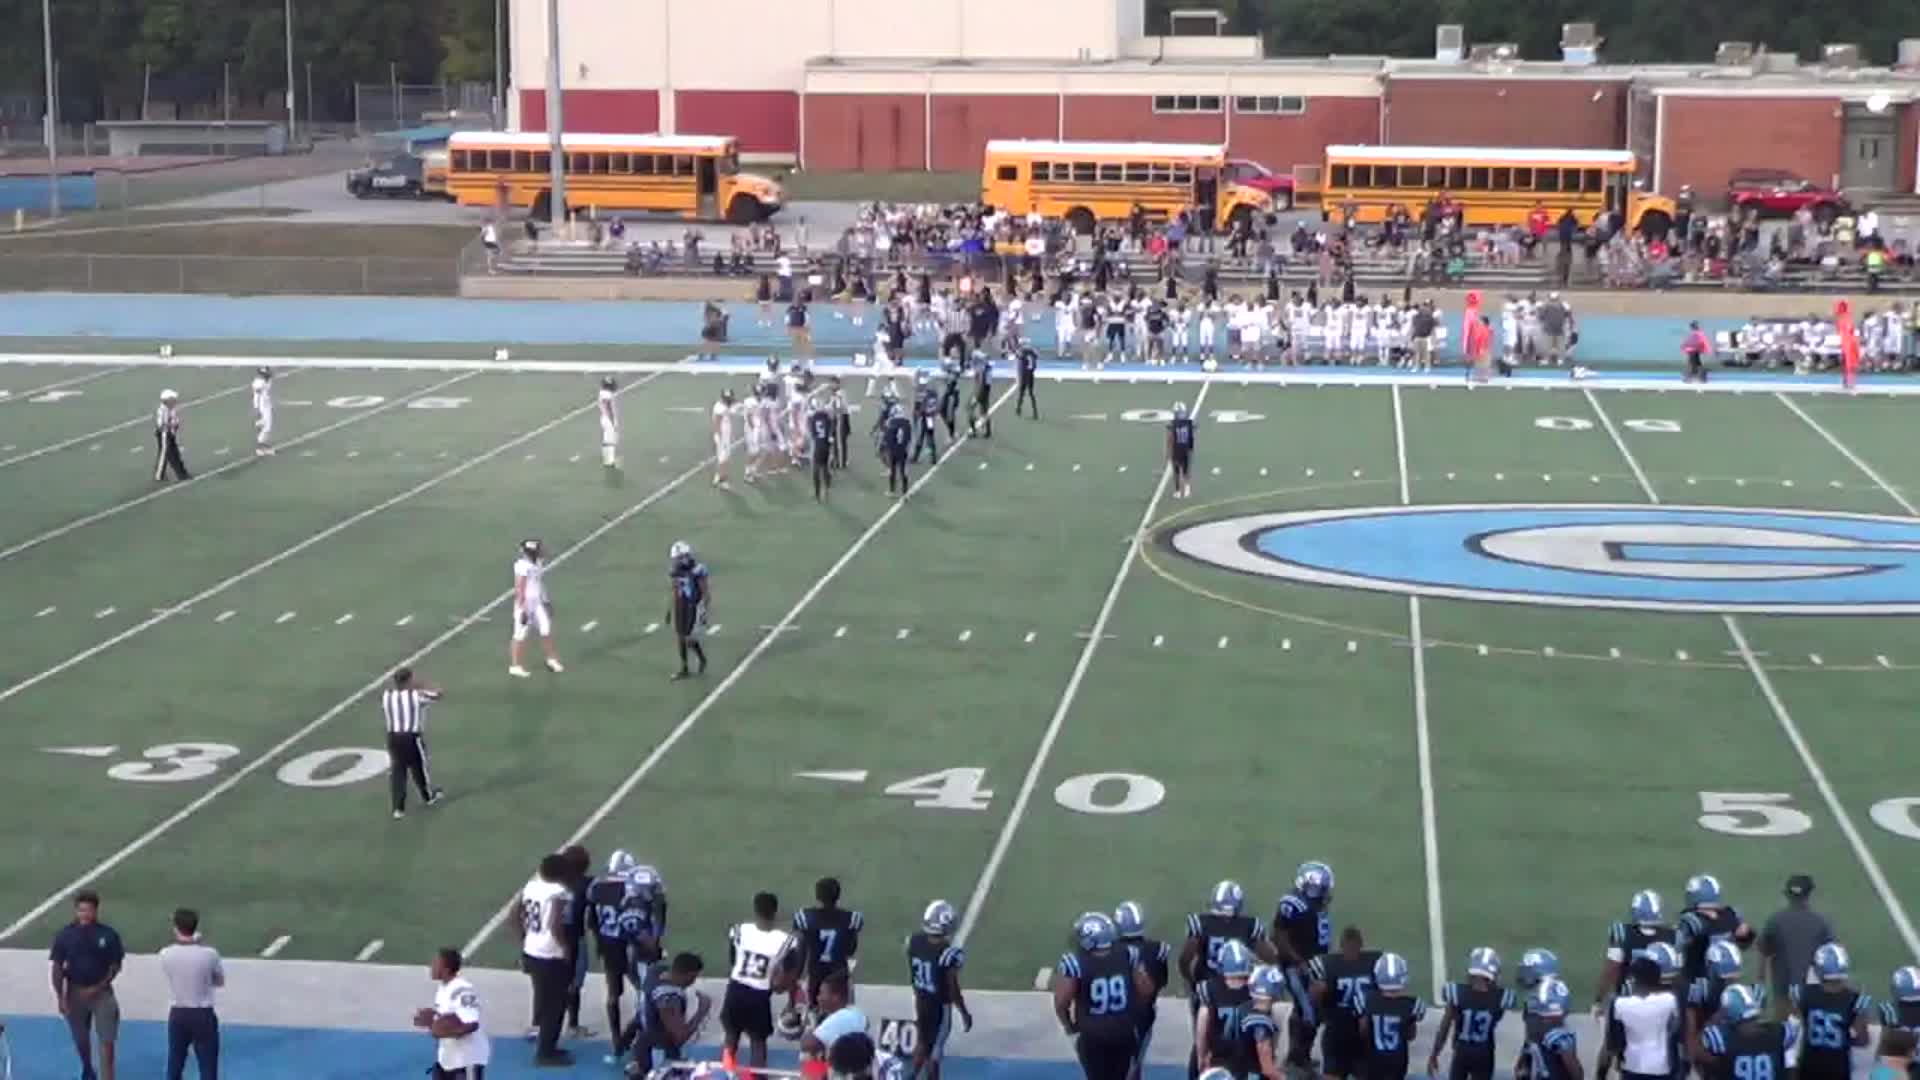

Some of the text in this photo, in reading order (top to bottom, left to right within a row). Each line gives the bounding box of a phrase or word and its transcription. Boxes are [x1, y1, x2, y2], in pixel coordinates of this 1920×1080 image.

[884, 767, 1165, 813] 40
[818, 928, 838, 962] 7
[1089, 975, 1128, 1014] 99
[881, 1022, 918, 1055] 40
[1372, 1015, 1400, 1051] 15
[1458, 1009, 1493, 1042] 13
